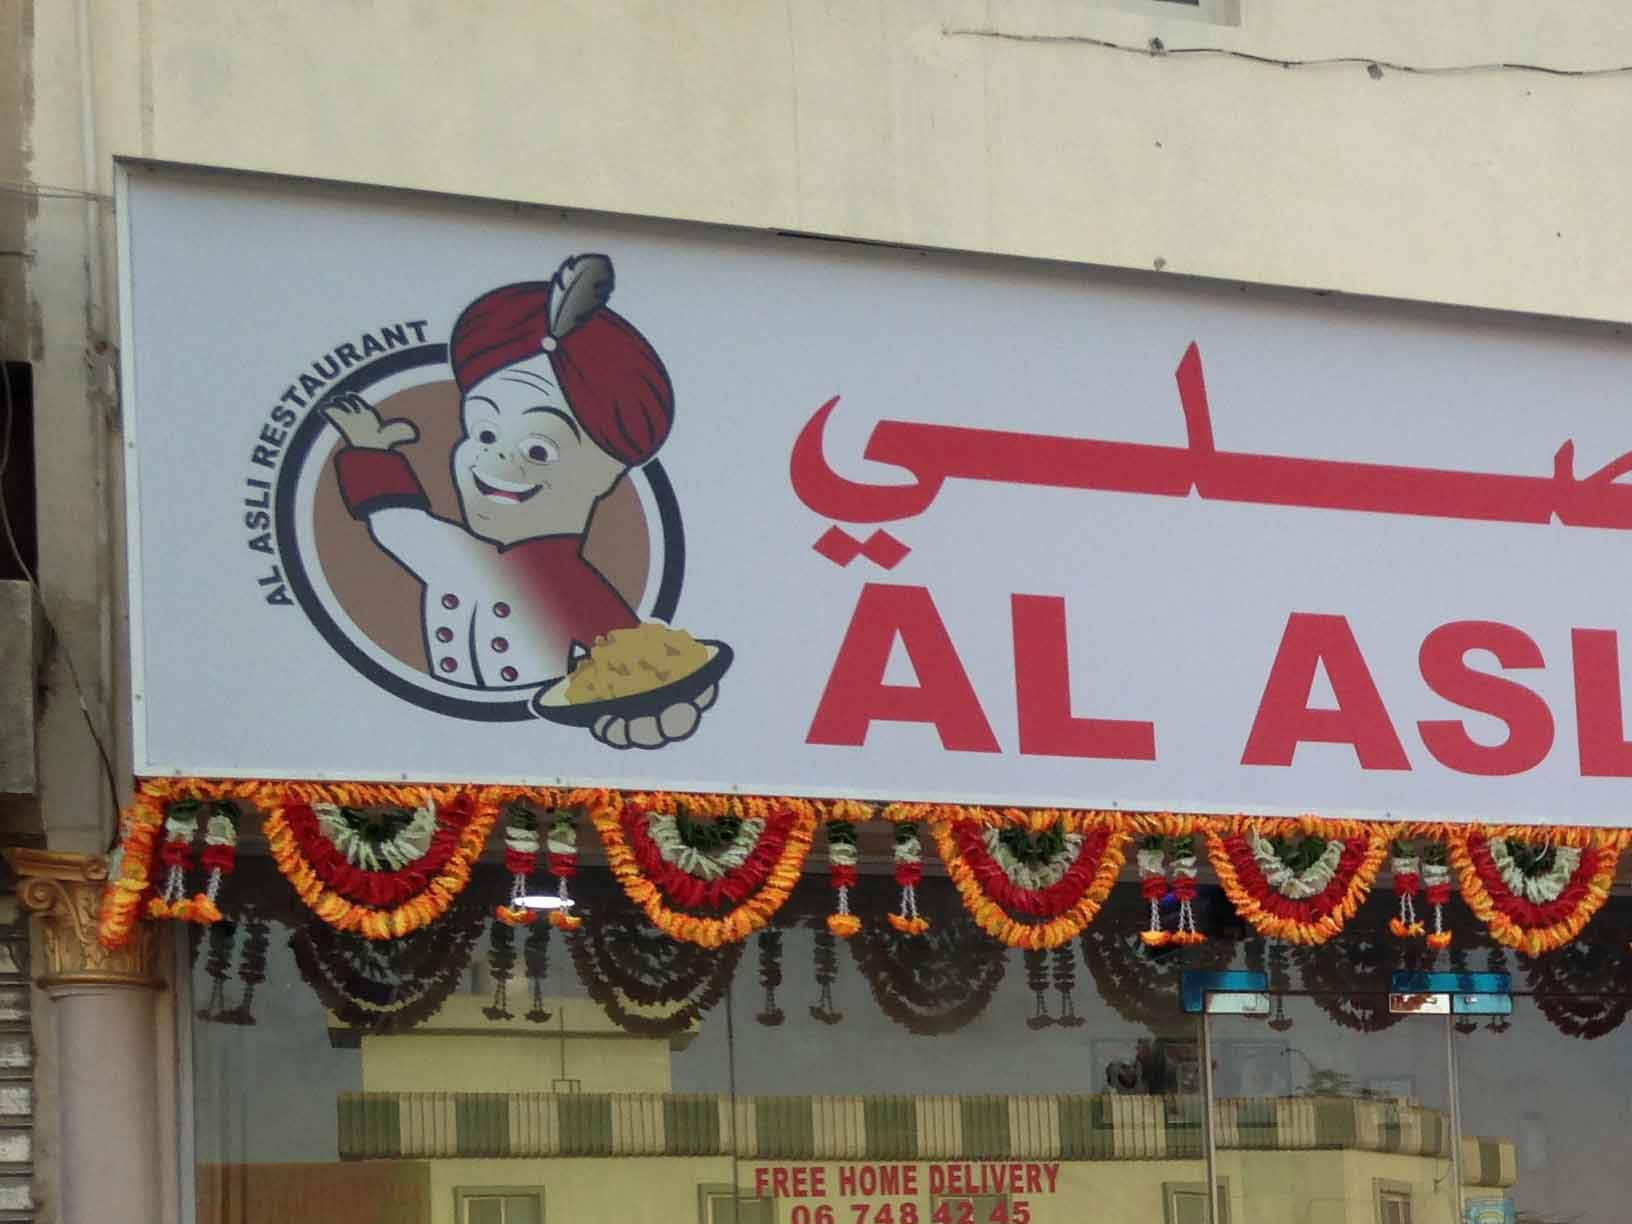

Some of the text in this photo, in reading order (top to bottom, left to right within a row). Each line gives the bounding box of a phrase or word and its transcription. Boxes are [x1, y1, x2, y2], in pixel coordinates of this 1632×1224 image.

[245, 318, 429, 607] AL ASLI RESTAURANT
[806, 582, 1157, 761] AL
[755, 1162, 1061, 1198] FREE HOME DELIVERY
